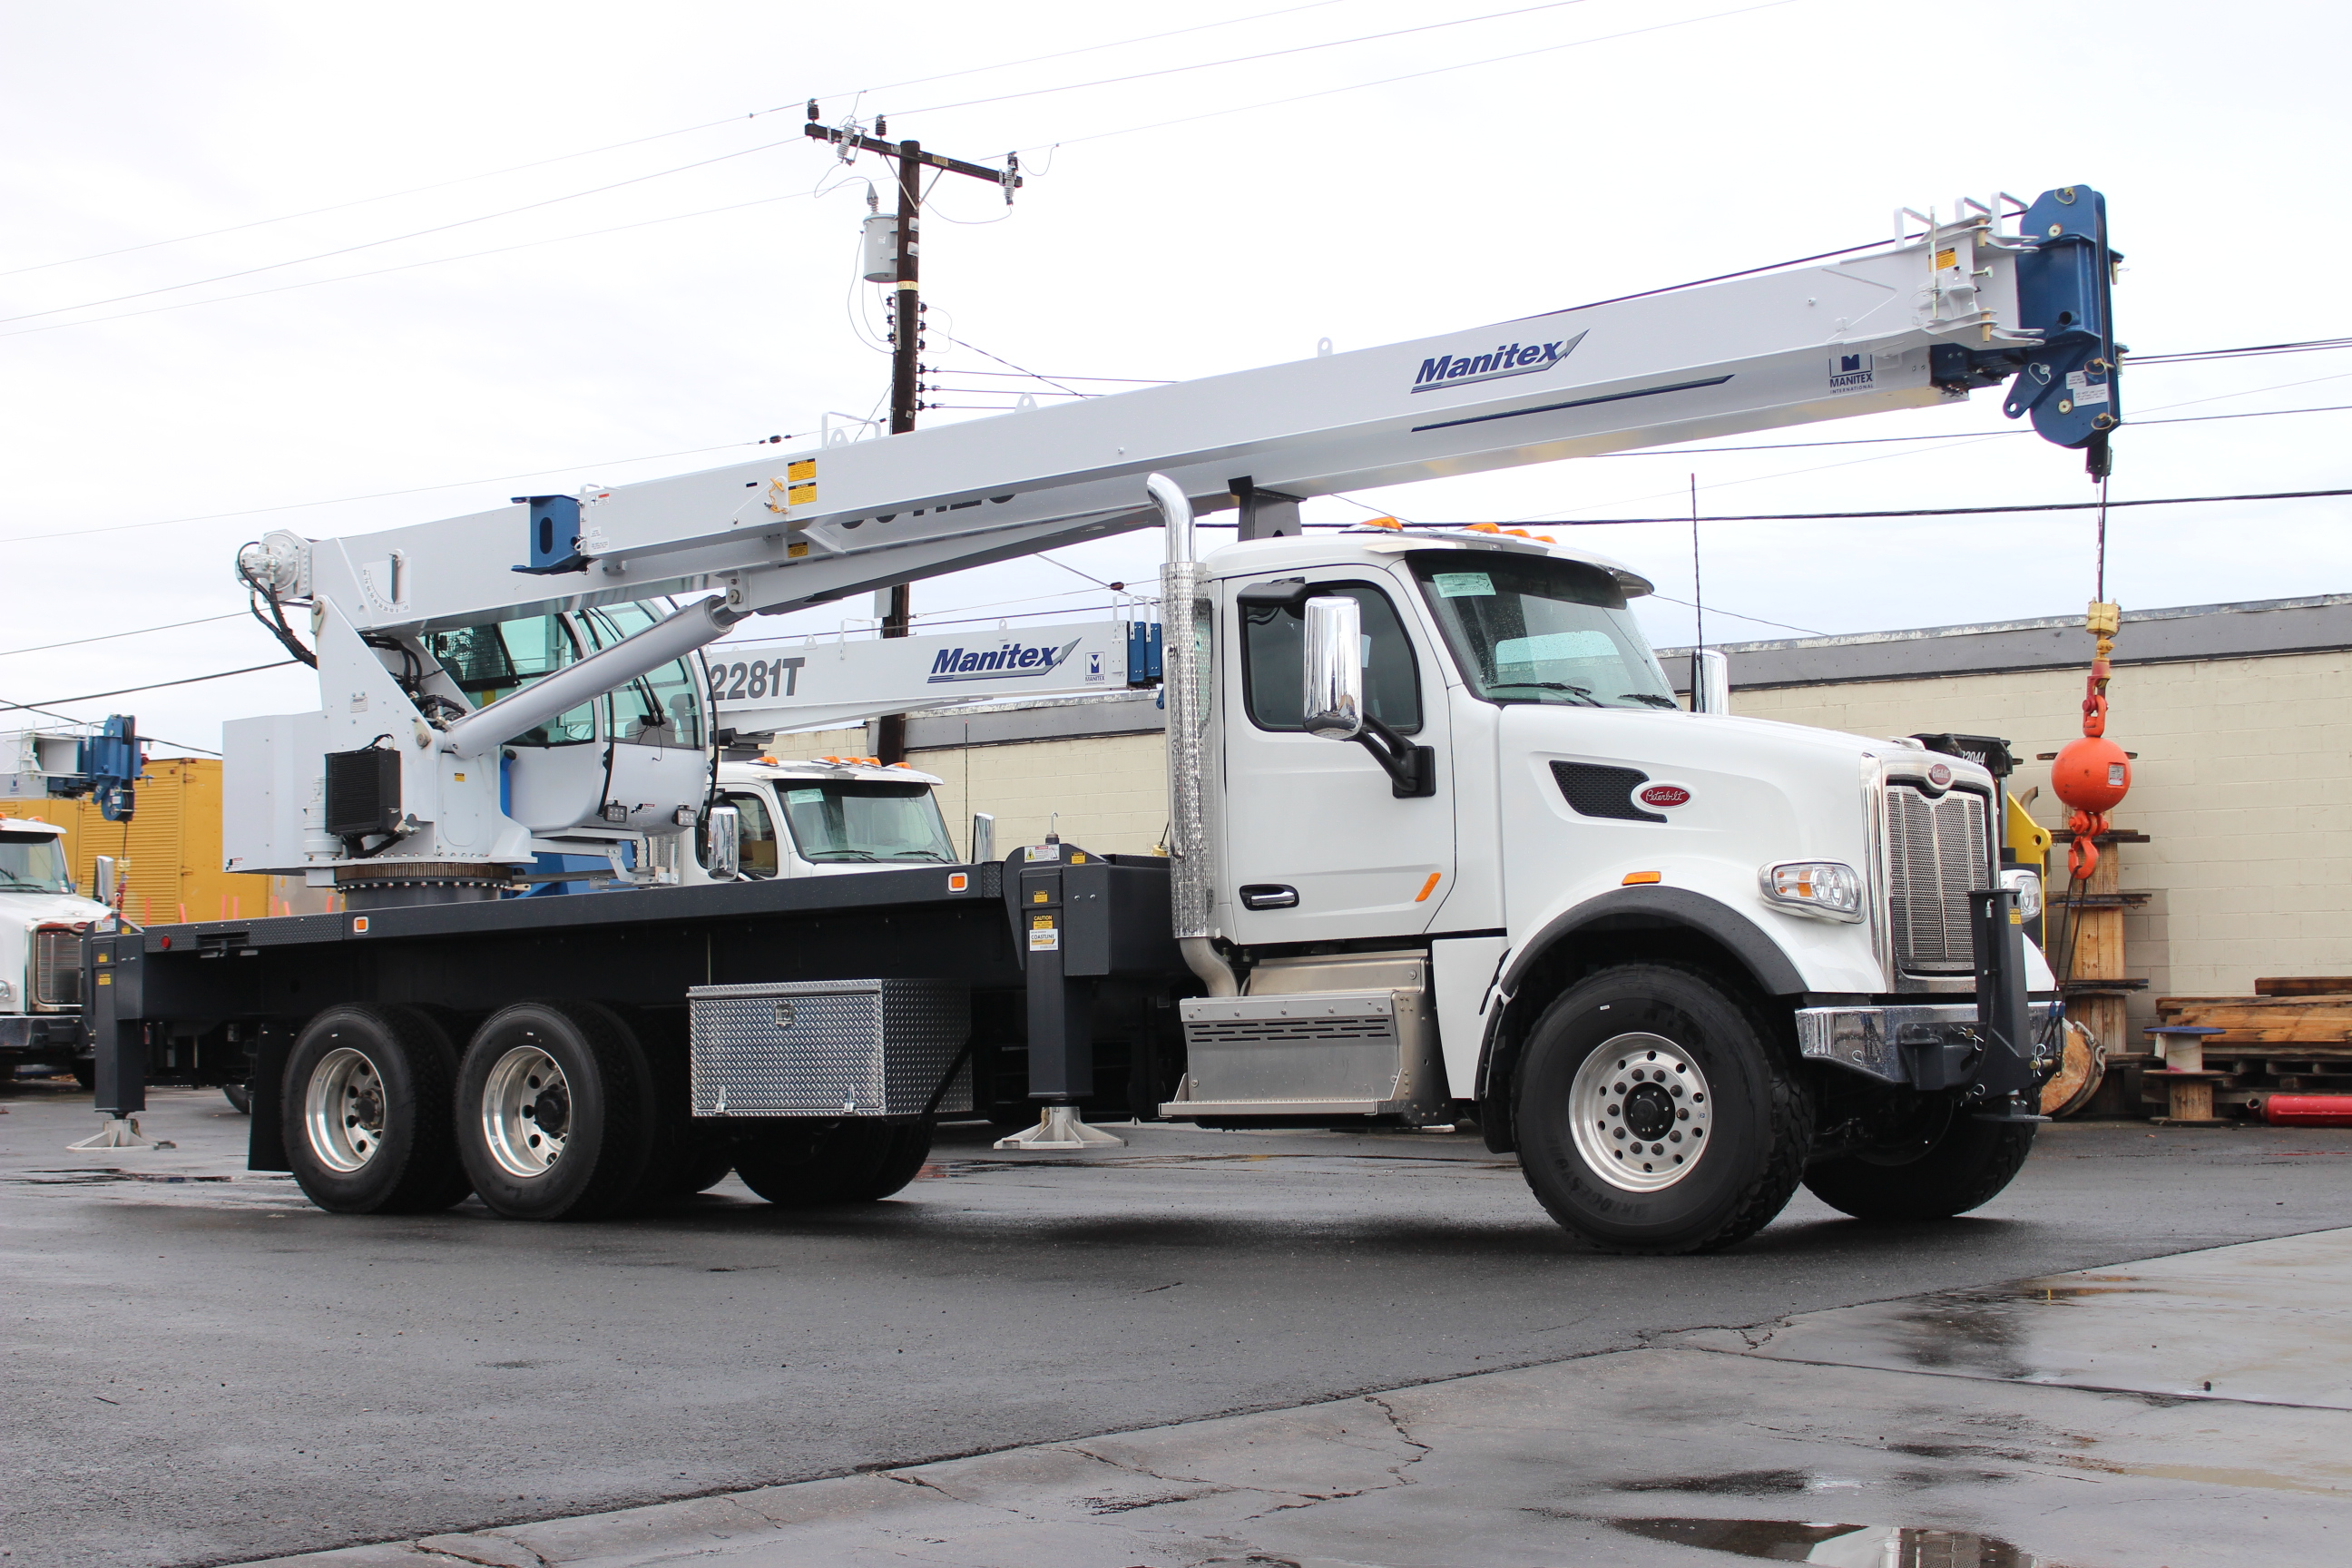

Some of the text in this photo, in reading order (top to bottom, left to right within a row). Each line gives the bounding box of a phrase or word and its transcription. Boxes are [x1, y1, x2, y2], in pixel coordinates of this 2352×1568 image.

[1415, 340, 1563, 385] Manitex
[1829, 373, 1873, 387] MANITEX
[1829, 384, 1874, 395] INTERNATIONAL
[930, 642, 1059, 674] Manitex
[706, 657, 805, 701] 2281T
[1645, 789, 1687, 801] Peterbilt
